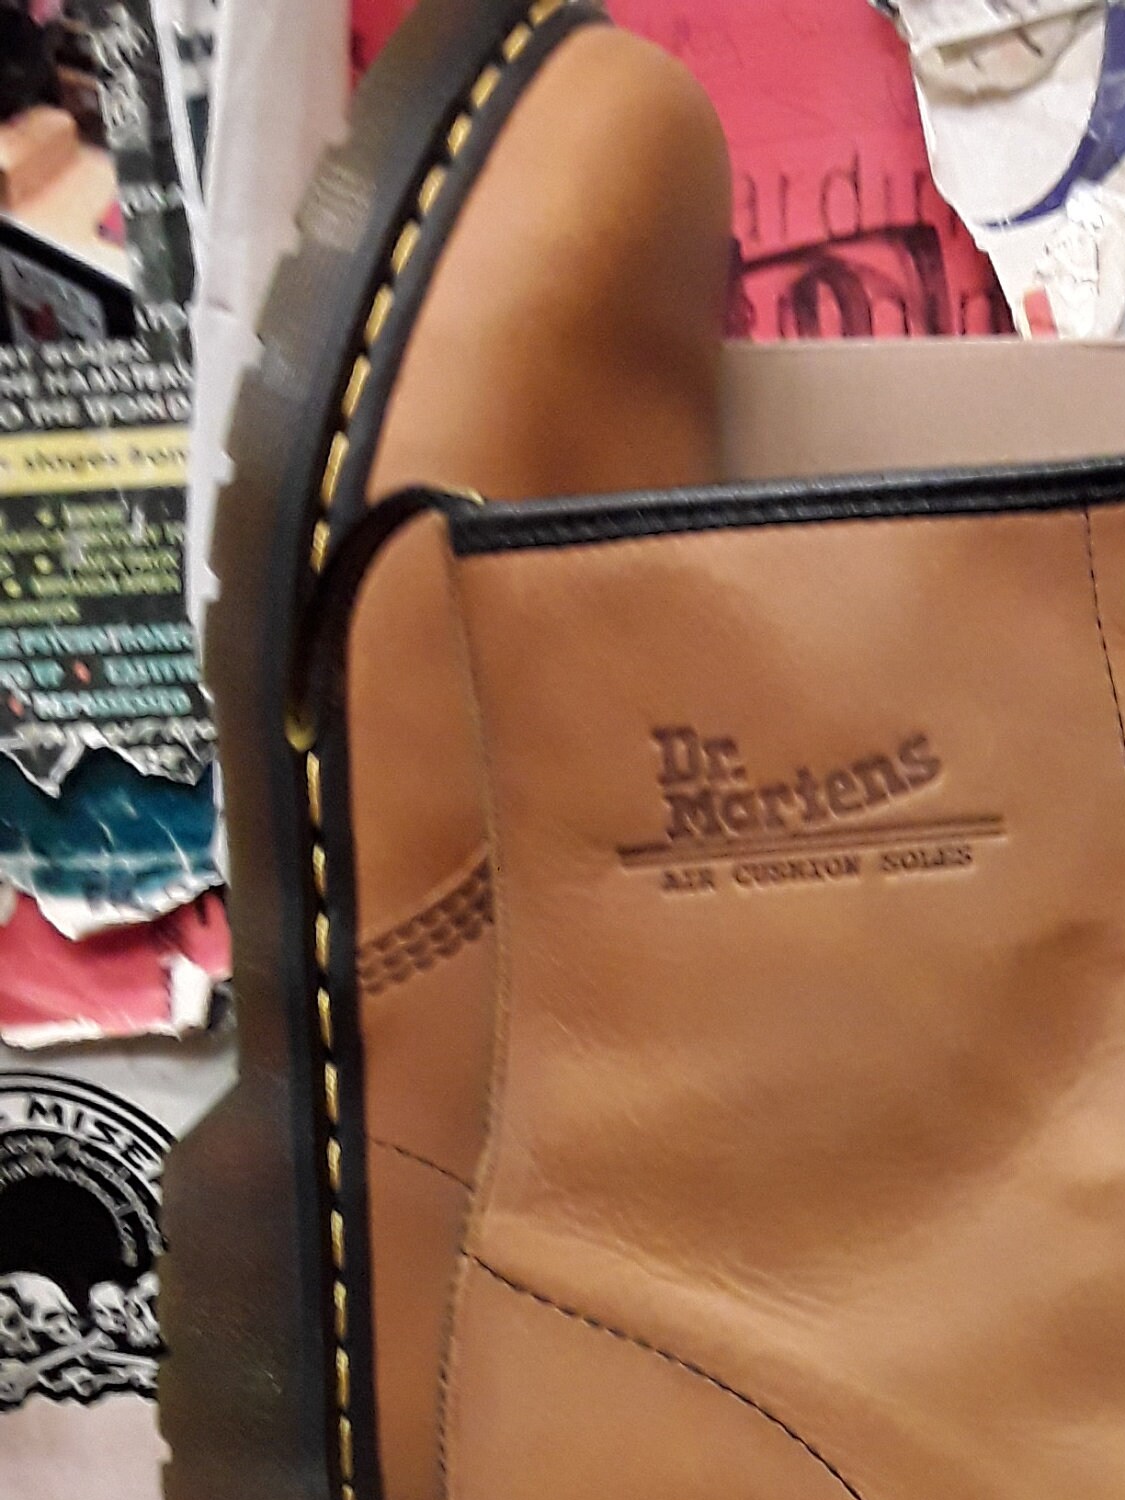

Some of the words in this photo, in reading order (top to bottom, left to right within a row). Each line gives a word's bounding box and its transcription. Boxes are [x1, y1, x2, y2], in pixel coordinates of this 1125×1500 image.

[652, 726, 747, 787] Dr.
[664, 731, 943, 841] Martens
[27, 1100, 160, 1184] MISE
